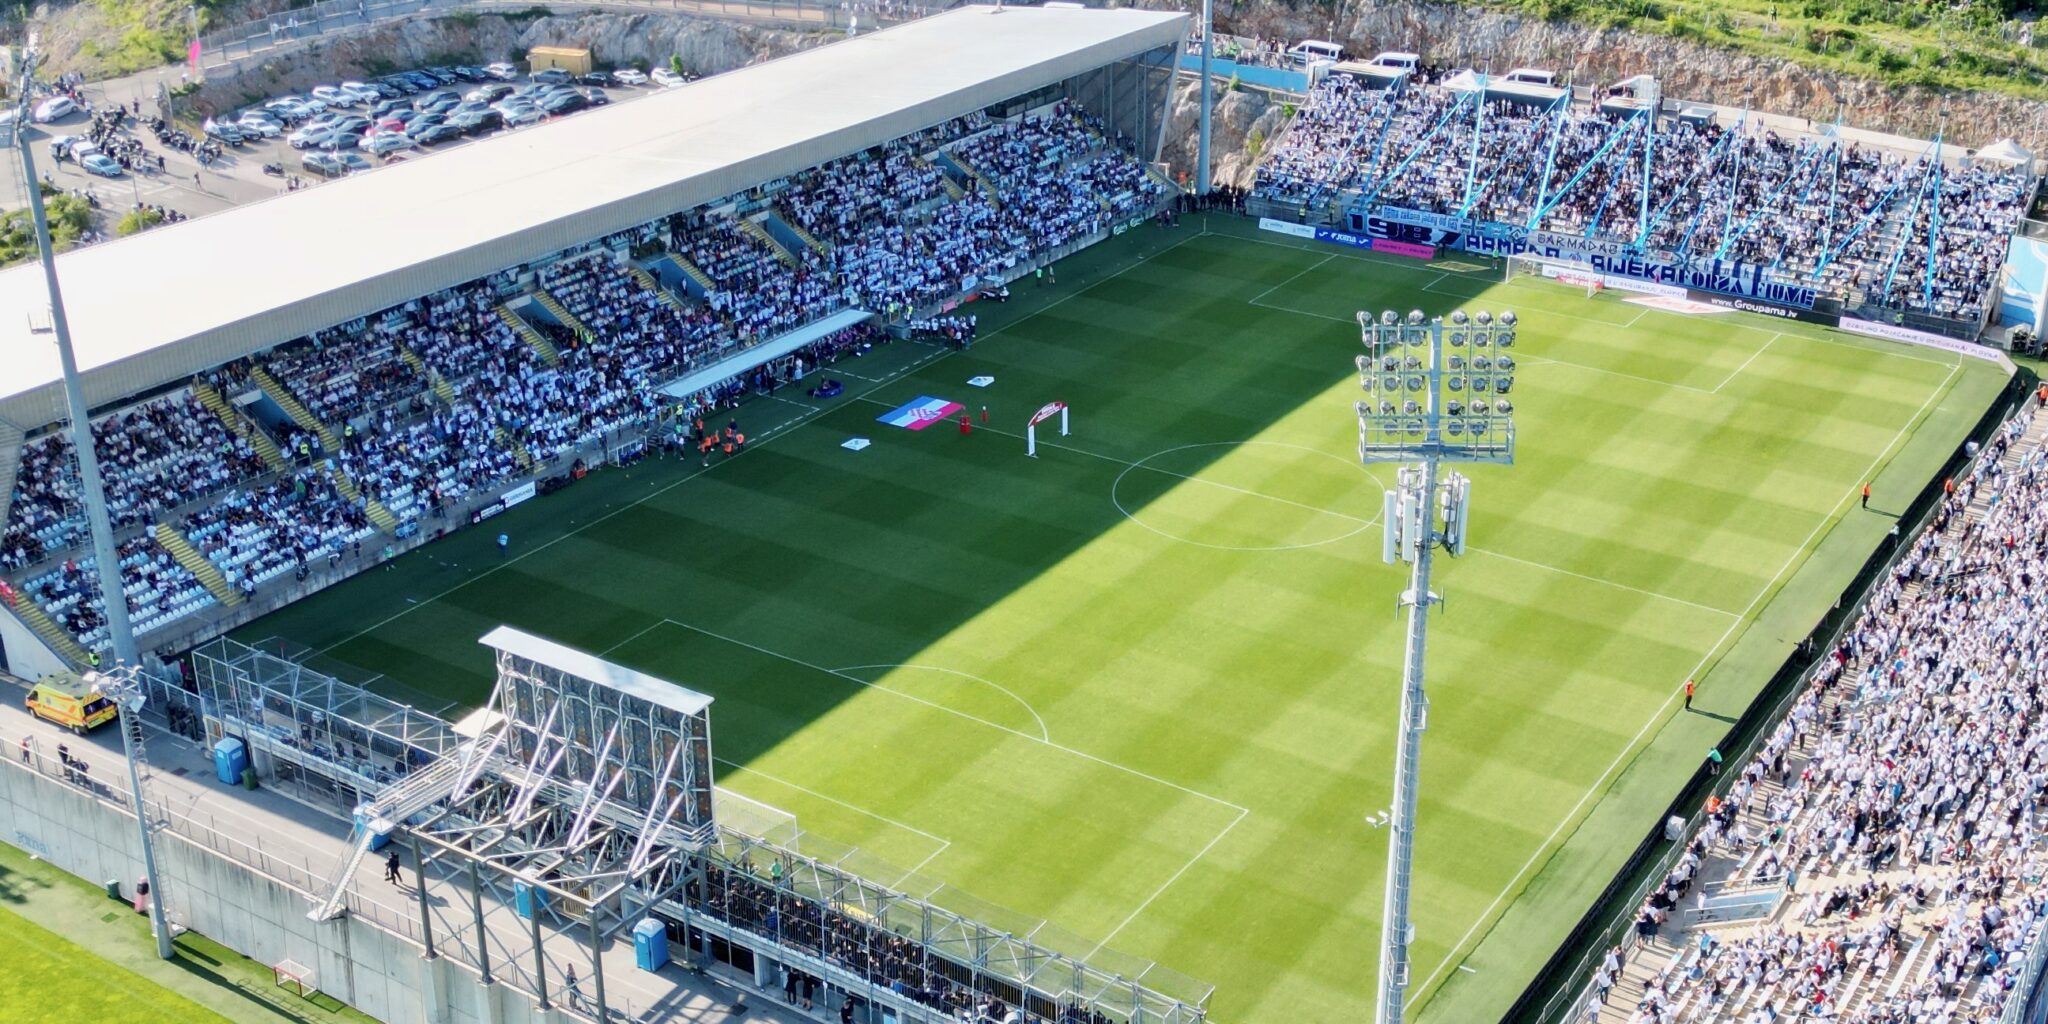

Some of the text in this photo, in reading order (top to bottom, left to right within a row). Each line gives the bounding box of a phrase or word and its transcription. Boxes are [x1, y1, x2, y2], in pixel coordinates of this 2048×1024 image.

[1591, 254, 1676, 282] RIJEKA
[1679, 268, 1816, 307] FORZA FIUME
